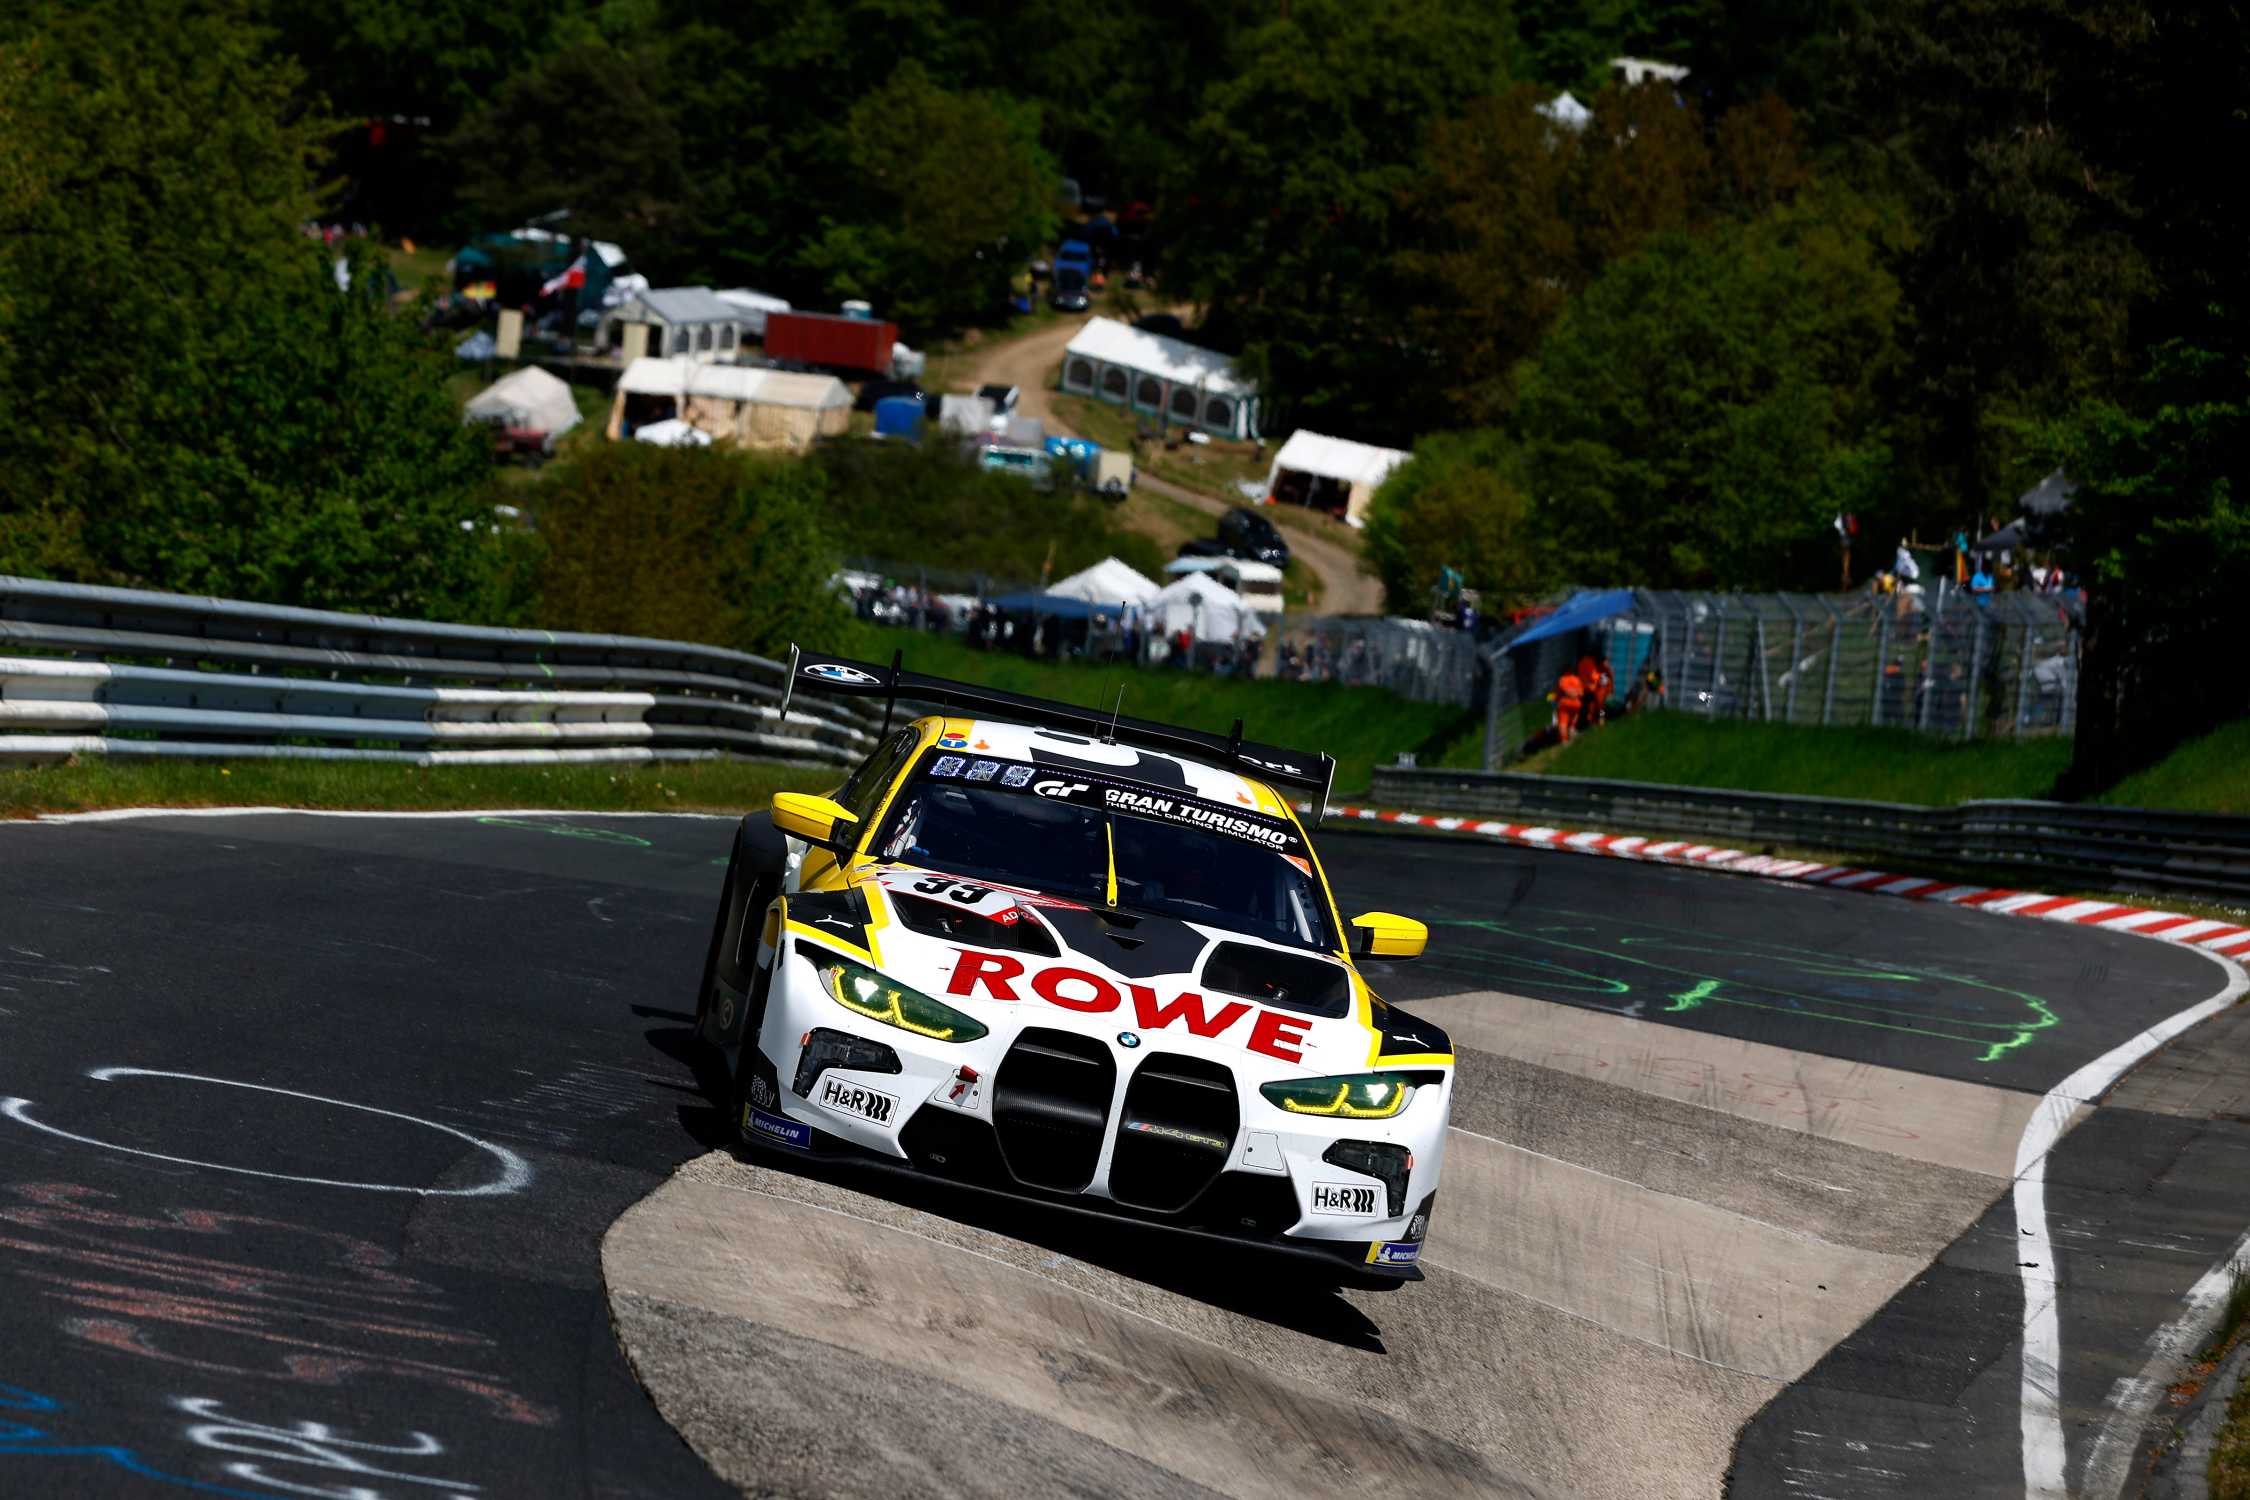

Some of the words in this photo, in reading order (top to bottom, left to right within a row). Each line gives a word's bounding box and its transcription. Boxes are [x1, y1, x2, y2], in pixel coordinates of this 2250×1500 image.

[1105, 789, 1173, 812] GRAN
[1105, 801, 1128, 810] THE
[1131, 805, 1163, 817] REAL
[1164, 813, 1214, 830] DRIVING
[1216, 826, 1284, 851] SIMULATOR
[945, 946, 1313, 1065] ROWE
[755, 1116, 800, 1139] MICHELIN
